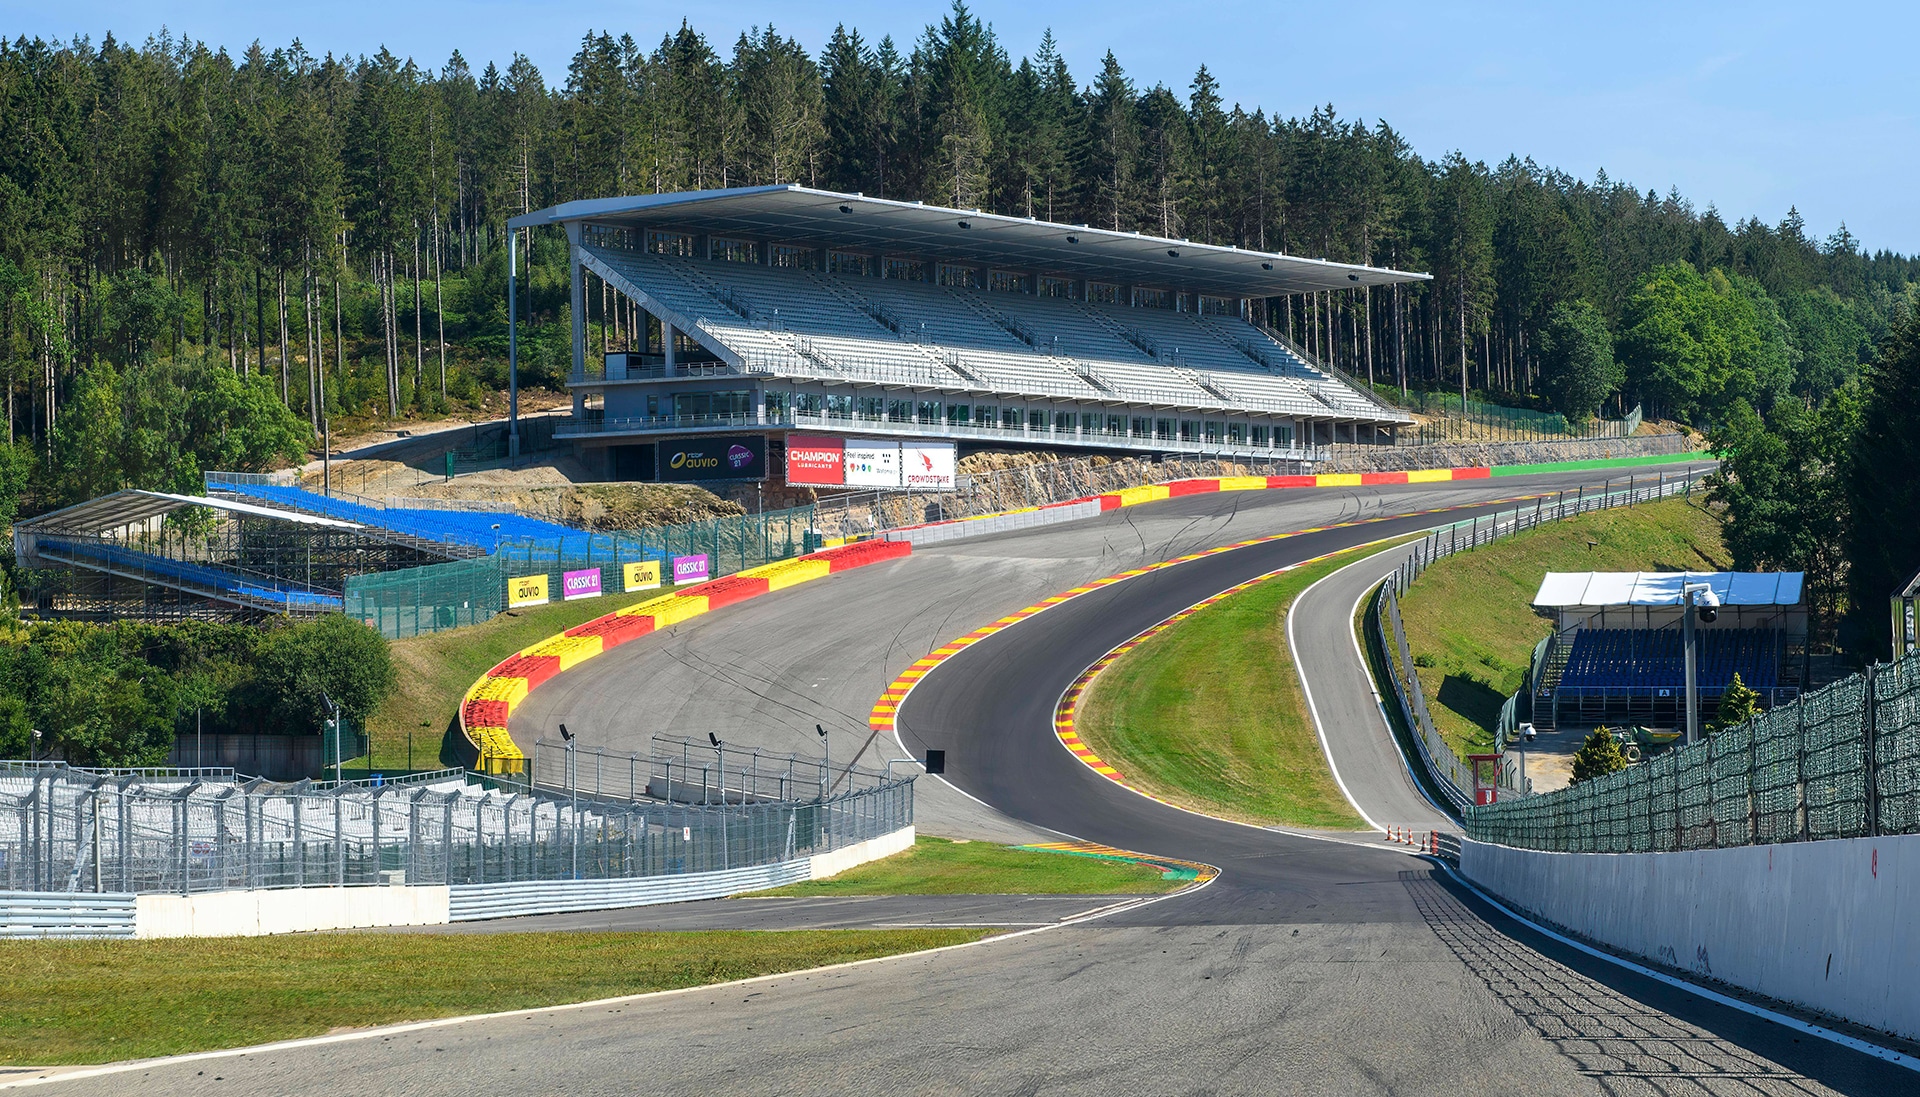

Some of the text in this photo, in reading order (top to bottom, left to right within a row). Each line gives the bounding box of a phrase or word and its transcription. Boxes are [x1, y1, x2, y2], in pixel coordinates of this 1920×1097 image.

[729, 451, 750, 461] CLASSIC
[790, 450, 840, 463] CHAMPION
[733, 460, 742, 468] 21
[676, 560, 705, 575] CLASSIC 21
[567, 575, 598, 590] CLASSIC 21
